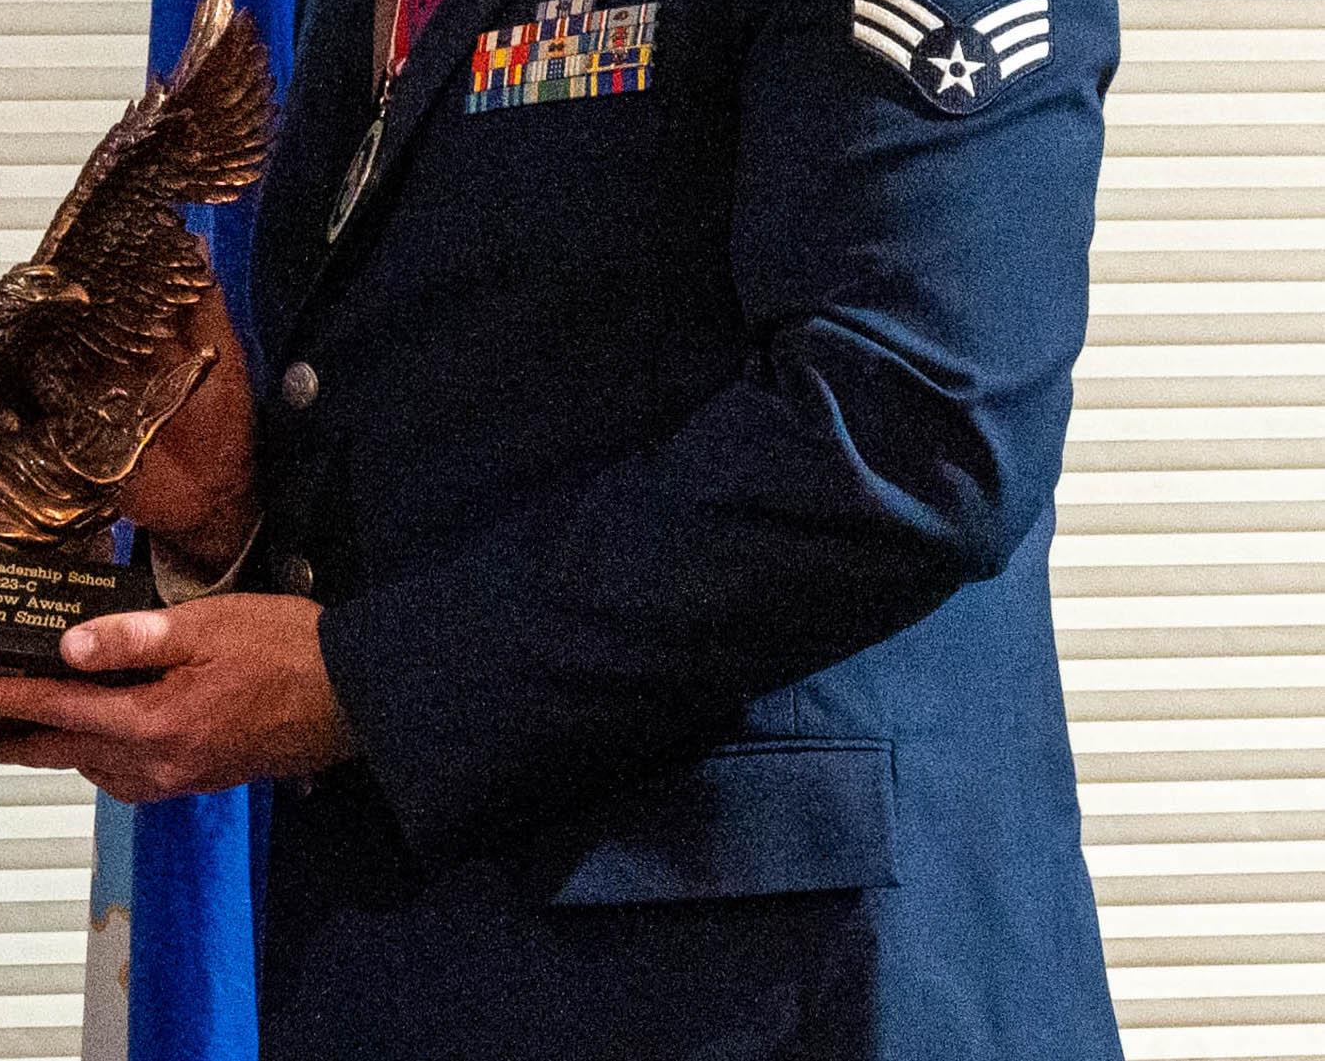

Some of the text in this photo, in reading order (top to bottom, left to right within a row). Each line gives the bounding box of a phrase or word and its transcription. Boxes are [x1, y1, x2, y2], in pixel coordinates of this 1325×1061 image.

[68, 571, 116, 588] School
[26, 596, 81, 614] Award
[15, 611, 67, 629] Smith
